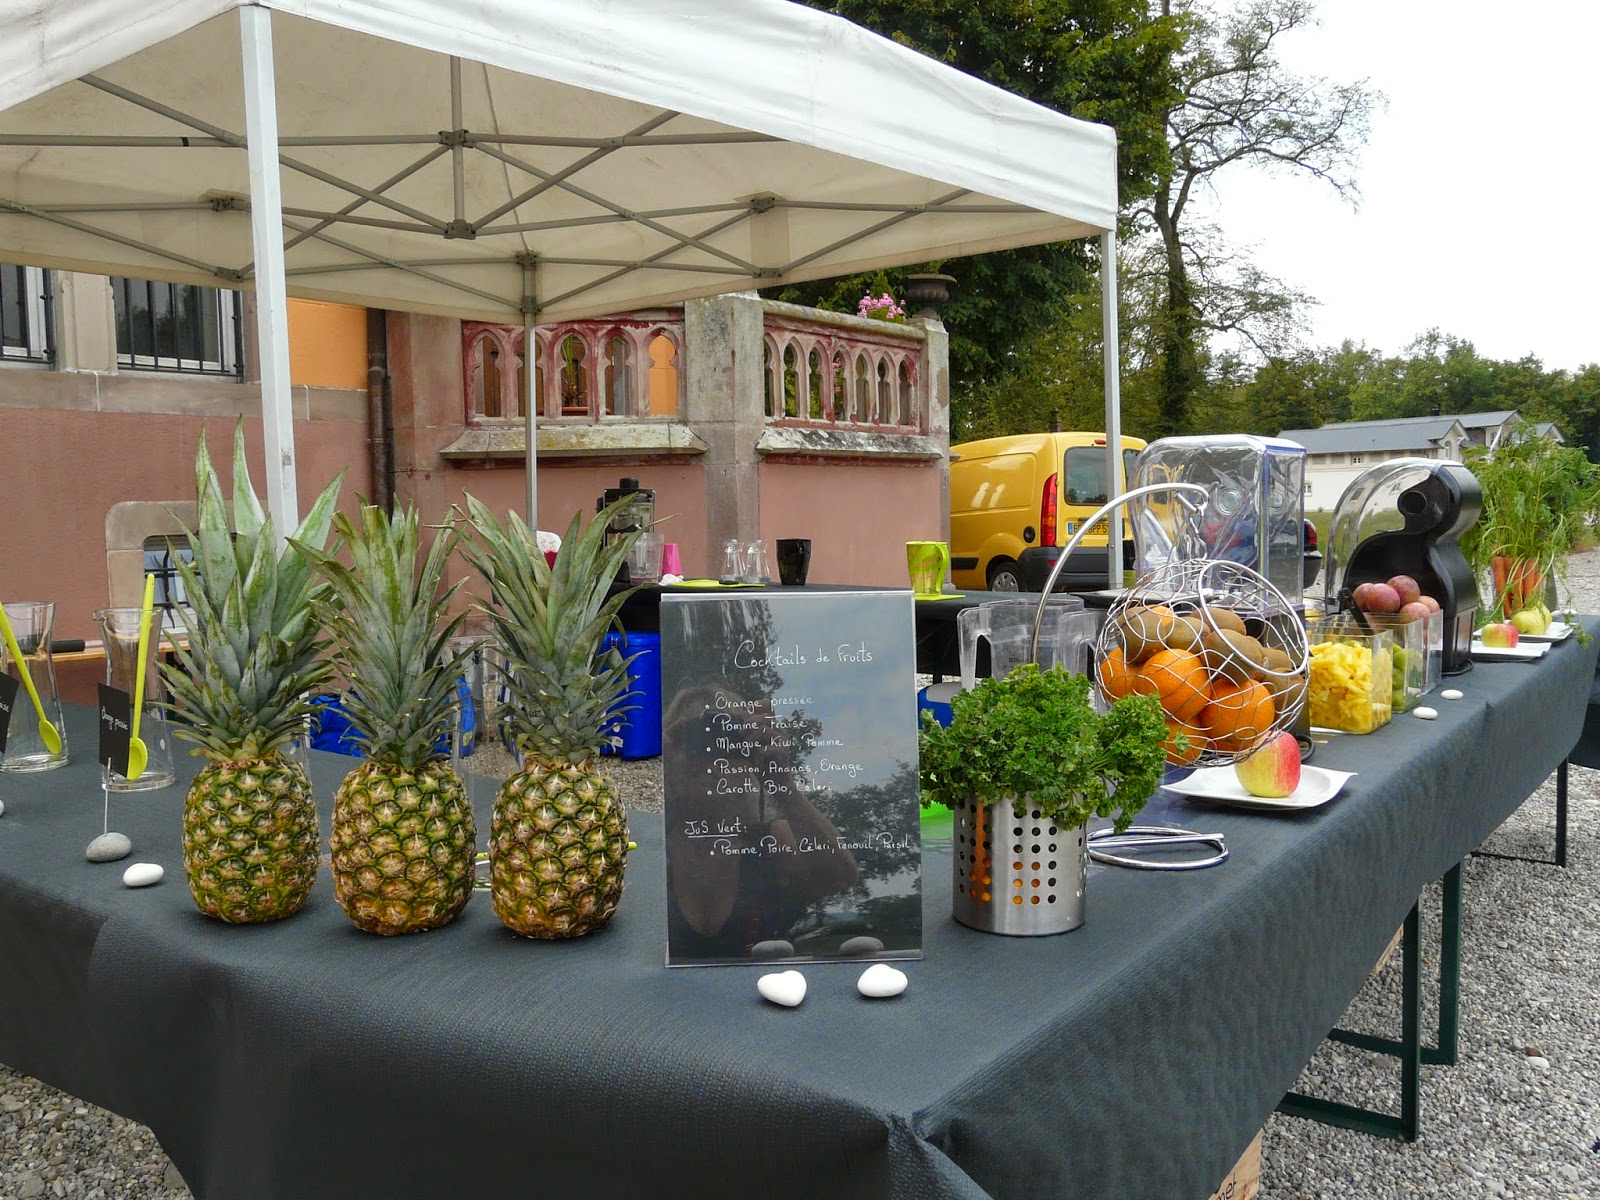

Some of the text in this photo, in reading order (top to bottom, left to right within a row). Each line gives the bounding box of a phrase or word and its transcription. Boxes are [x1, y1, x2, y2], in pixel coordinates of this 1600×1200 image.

[816, 648, 830, 663] de
[714, 691, 762, 714] Orange
[801, 733, 844, 748] Pomme
[820, 758, 864, 777] Orange
[716, 778, 759, 795] Carotte
[876, 831, 911, 849] Persil
